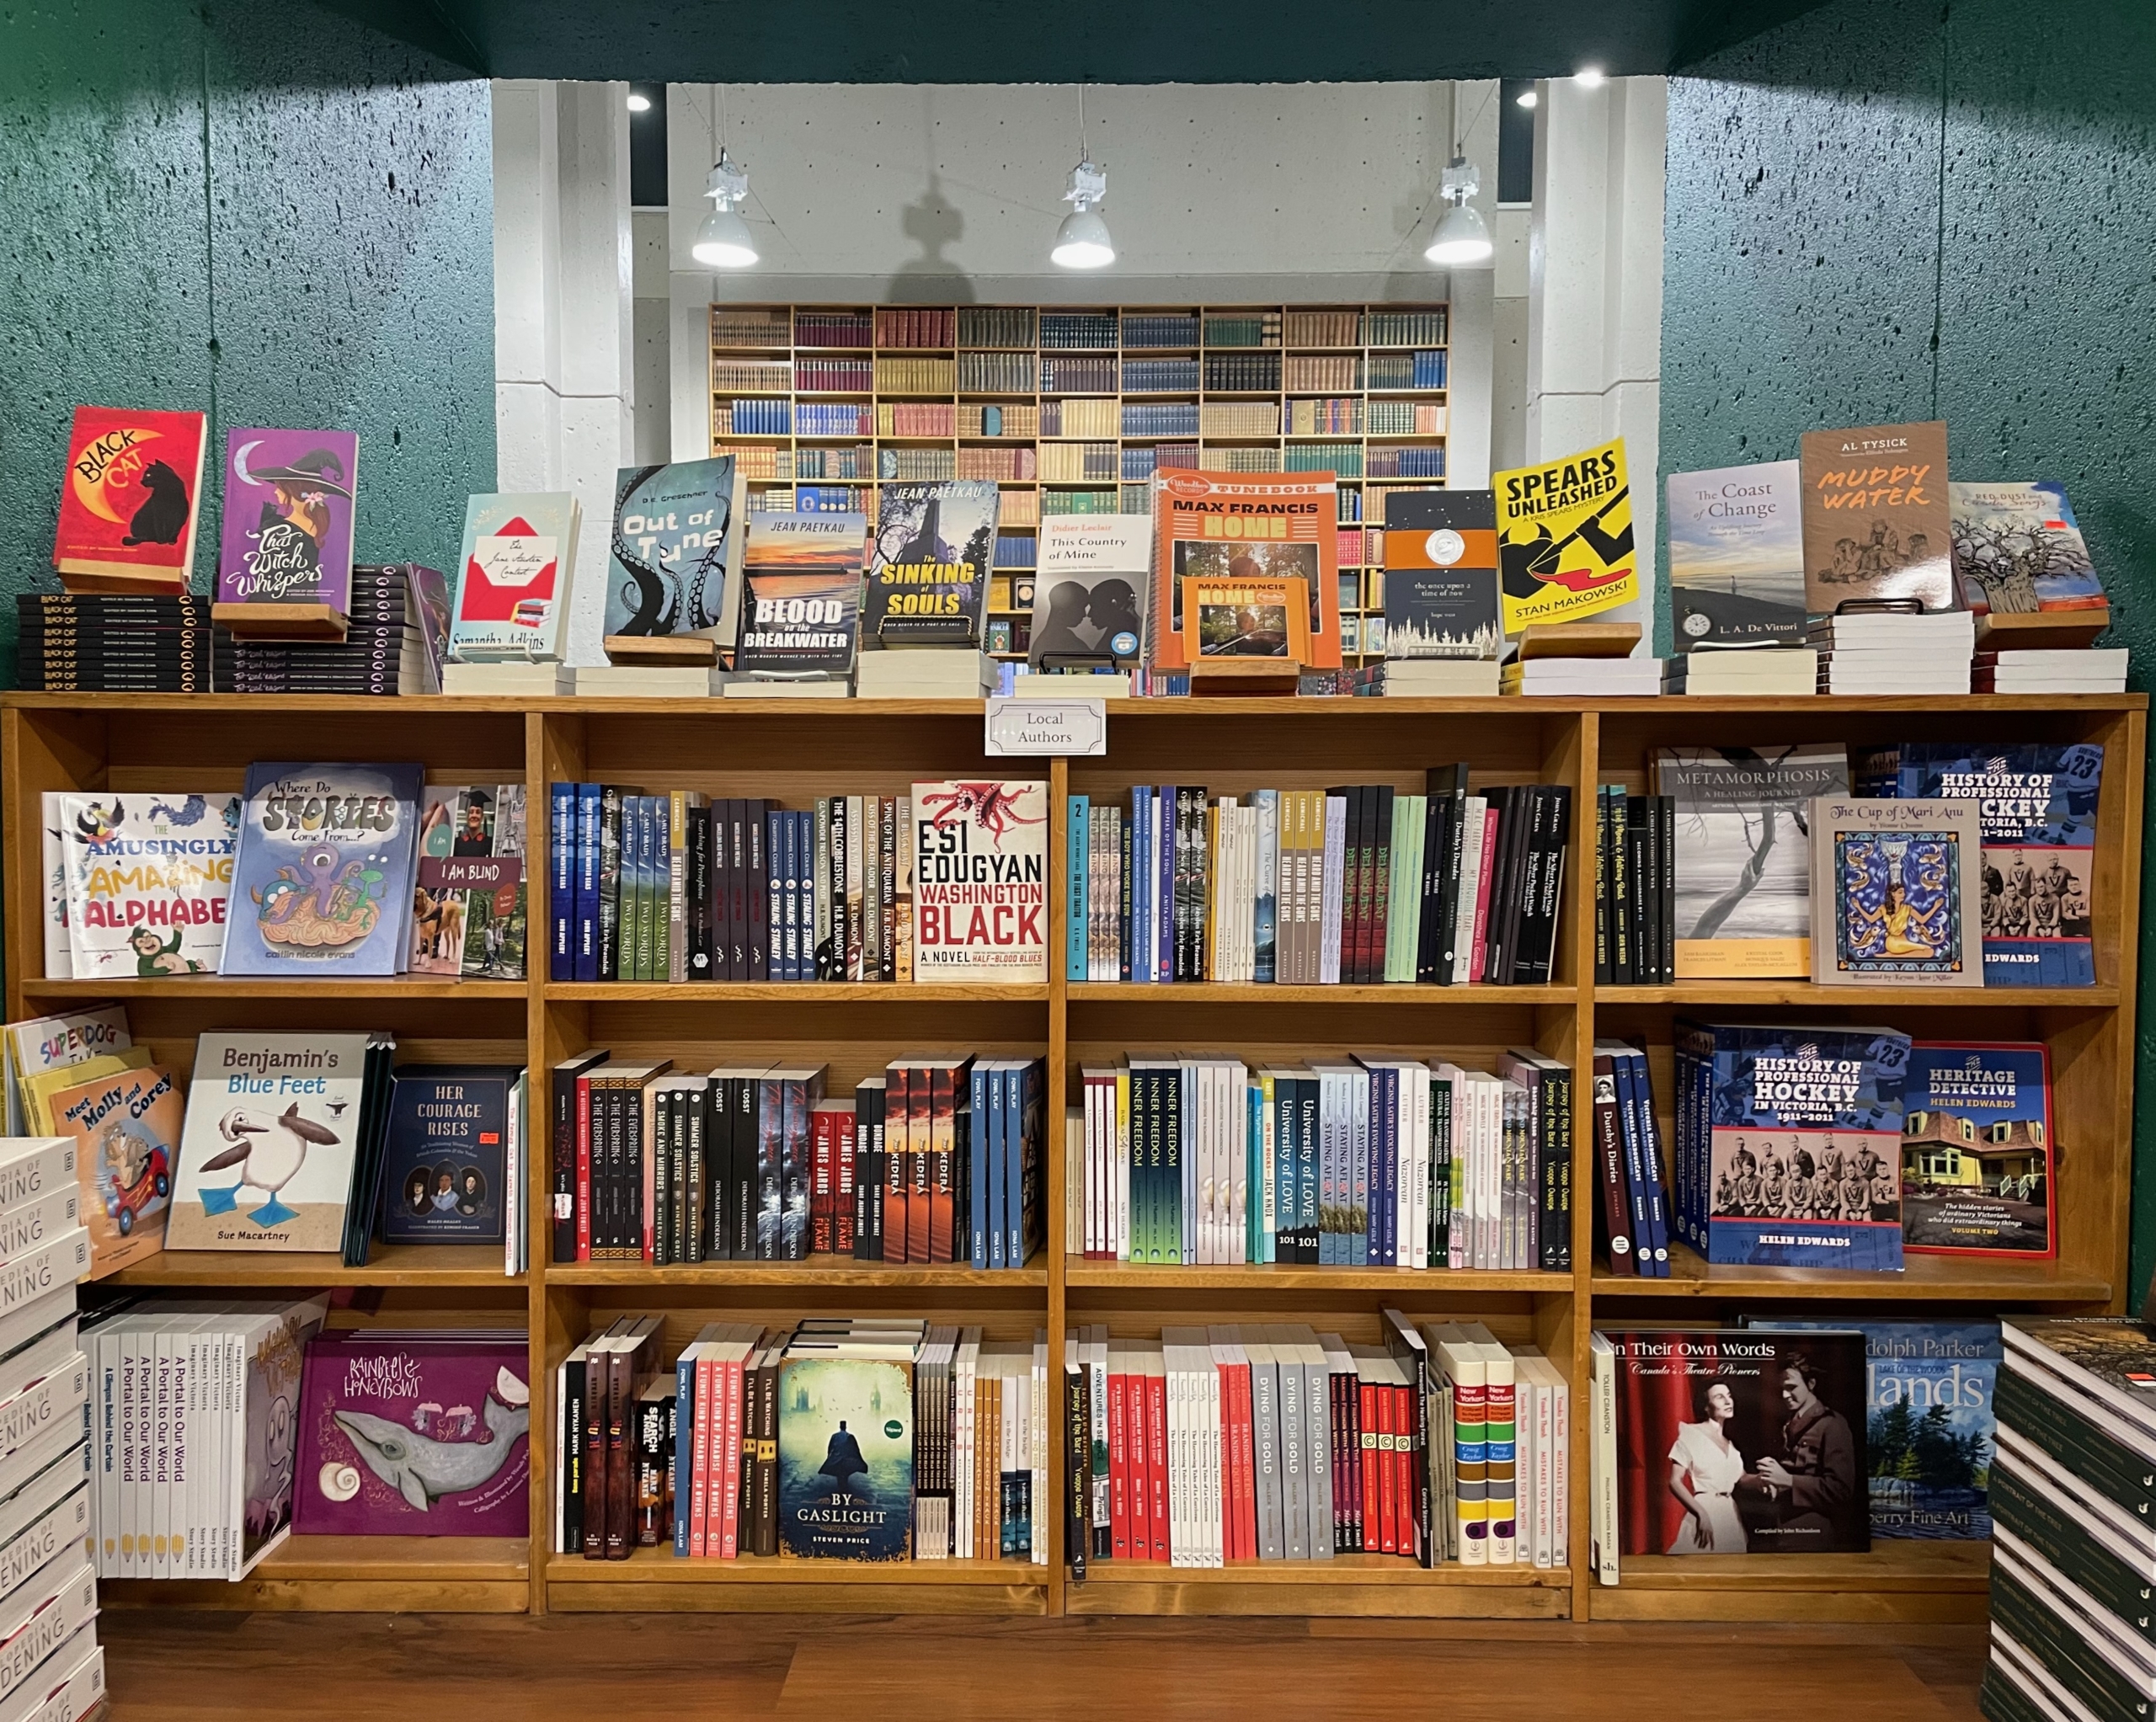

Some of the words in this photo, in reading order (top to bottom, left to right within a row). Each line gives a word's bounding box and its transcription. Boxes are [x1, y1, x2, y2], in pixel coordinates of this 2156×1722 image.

[1841, 442, 1858, 451] AL
[1861, 438, 1908, 450] TYSICK
[74, 430, 137, 484] BLACK
[106, 447, 143, 488] CAT
[1507, 450, 1616, 502] SPEARS
[1817, 465, 1931, 489] MUDDY
[661, 490, 709, 503] Greschner
[894, 488, 926, 500] JEAN
[928, 486, 983, 498] PAETKAU
[1175, 487, 1205, 495] RECORDS
[1217, 485, 1319, 494] TUNEBOOK
[1508, 475, 1618, 519] UNLEASHED
[1694, 490, 1718, 501] The
[1721, 482, 1773, 498] Coast
[1823, 486, 1931, 510] WATER
[1172, 499, 1225, 513] MAX
[1229, 504, 1319, 514] FRANCIS
[1693, 509, 1705, 521] of
[1708, 502, 1777, 520] Change
[623, 512, 680, 536] Out
[687, 509, 715, 526] of
[771, 521, 798, 532] JEAN
[799, 522, 846, 533] PAETKAU
[1051, 525, 1080, 533] Didier
[1081, 524, 1113, 532] Leclair
[1204, 514, 1288, 538] HOME
[245, 524, 304, 554] That
[638, 529, 723, 563] Tune
[1050, 538, 1075, 547] This
[1078, 537, 1128, 548] Country
[243, 542, 309, 575] Witch
[923, 554, 937, 563] The
[1049, 550, 1061, 560] of
[1064, 549, 1097, 560] Mine
[226, 563, 325, 600] Whispers
[880, 562, 976, 585] SINKING
[1414, 581, 1428, 589] the
[1446, 583, 1465, 591] upon
[887, 593, 961, 616] SOULS
[1198, 590, 1256, 604] HOME
[1515, 603, 1551, 618] STAN
[1553, 579, 1628, 610] MAKOWSKI
[755, 599, 844, 624] BLOOD
[1748, 624, 1763, 632] De
[1764, 622, 1798, 632] Vittori
[744, 632, 848, 648] BREAKWATER
[1027, 712, 1064, 725] Local
[1017, 731, 1073, 744] Authors
[1677, 768, 1831, 785] METAMORPHOSIS
[1941, 774, 2026, 788] HISTORY
[2031, 774, 2053, 788] OF
[274, 781, 312, 793] Where
[316, 781, 332, 793] Do
[1713, 789, 1757, 799] HEALING
[1758, 788, 1804, 799] JOURNEY
[1941, 786, 2052, 799] PROFESSIONAL
[262, 790, 397, 832] STORIES
[834, 802, 844, 815] THE
[1830, 805, 1854, 821] The
[1857, 806, 1884, 821] Cup
[1886, 805, 1897, 822] of
[1900, 805, 1934, 818] Mari
[1937, 806, 1965, 818] Anu
[153, 824, 169, 835] THE
[291, 829, 320, 842] Come
[918, 819, 969, 854] ESI
[1164, 833, 1171, 842] OF
[1453, 821, 1464, 851] Dutchy's
[86, 838, 237, 856] AMUSINGLY
[447, 864, 465, 881] AM
[467, 864, 501, 882] BLIND
[834, 839, 844, 893] COBBLESTONE
[918, 854, 1043, 884] EDUGYAN
[1451, 852, 1461, 880] Decades
[919, 883, 1043, 904] WASHINGTON
[83, 897, 229, 929] ALPHABE
[771, 893, 781, 925] STEALING
[919, 904, 1044, 946] BLACK
[770, 928, 781, 961] STANLEY
[834, 925, 844, 961] DUMONT
[932, 951, 971, 963] NOVEL
[972, 954, 1018, 963] HALF-BLOOD
[1019, 954, 1043, 963] BLUES
[1984, 953, 2040, 964] EDWARDS
[40, 1023, 117, 1065] SUPERDOG
[222, 1047, 339, 1074] Benjamin's
[1754, 1057, 1835, 1073] HISTORY
[1838, 1059, 1863, 1073] OF
[227, 1072, 275, 1095] Blue
[279, 1074, 327, 1096] Feet
[1754, 1069, 1860, 1085] PROFESSIONAL
[1929, 1068, 2015, 1084] HERITAGE
[123, 1082, 142, 1106] and
[129, 1071, 173, 1120] Corey
[435, 1085, 464, 1100] HER
[1133, 1077, 1144, 1112] INNER
[1754, 1082, 1860, 1102] HOCKEY
[1929, 1082, 2017, 1096] DETECTIVE
[65, 1096, 92, 1122] Meet
[82, 1085, 124, 1132] Molly
[417, 1103, 483, 1118] COURAGE
[593, 1102, 604, 1116] THE
[1771, 1101, 1833, 1112] VICTORIA,
[1834, 1101, 1858, 1112] B.C.
[1929, 1097, 1964, 1107] HELEN
[1967, 1098, 2016, 1109] EDWARDS
[427, 1122, 469, 1137] RISES
[593, 1117, 604, 1159] EVERSPRING
[1278, 1099, 1294, 1162] University
[1604, 1110, 1617, 1150] Dutchy's
[816, 1134, 830, 1165] JAMES
[1133, 1114, 1144, 1167] FREEDOM
[889, 1152, 900, 1196] KEDERA
[1280, 1164, 1293, 1178] of
[1607, 1151, 1618, 1185] Diaries
[816, 1165, 830, 1196] JAROS
[1281, 1180, 1294, 1214] LOVE
[216, 1230, 236, 1240] Sue
[237, 1231, 291, 1243] Macartney
[1278, 1235, 1296, 1245] 101
[1758, 1234, 1795, 1246] HELEN
[1797, 1235, 1851, 1247] EDWARDS
[1630, 1342, 1673, 1357] Their
[1677, 1342, 1718, 1357] Own
[1721, 1342, 1776, 1357] Words
[1923, 1338, 1985, 1358] Parker
[1629, 1361, 1678, 1377] Canada's
[1678, 1362, 1716, 1376] Theatre
[1716, 1362, 1761, 1377] Pioneers
[123, 1367, 135, 1405] Portal
[1259, 1377, 1270, 1414] DYING
[1460, 1385, 1477, 1394] New
[1460, 1394, 1486, 1403] Yorkers
[122, 1406, 133, 1419] to
[123, 1421, 135, 1444] Our
[1261, 1415, 1271, 1439] FOR
[123, 1445, 135, 1483] World
[1262, 1442, 1273, 1474] GOLD
[831, 1493, 853, 1507] BY
[797, 1508, 888, 1524] GASLIGHT
[1910, 1509, 1942, 1524] Fine
[1945, 1510, 1969, 1526] Art
[812, 1536, 844, 1544] STEVEN
